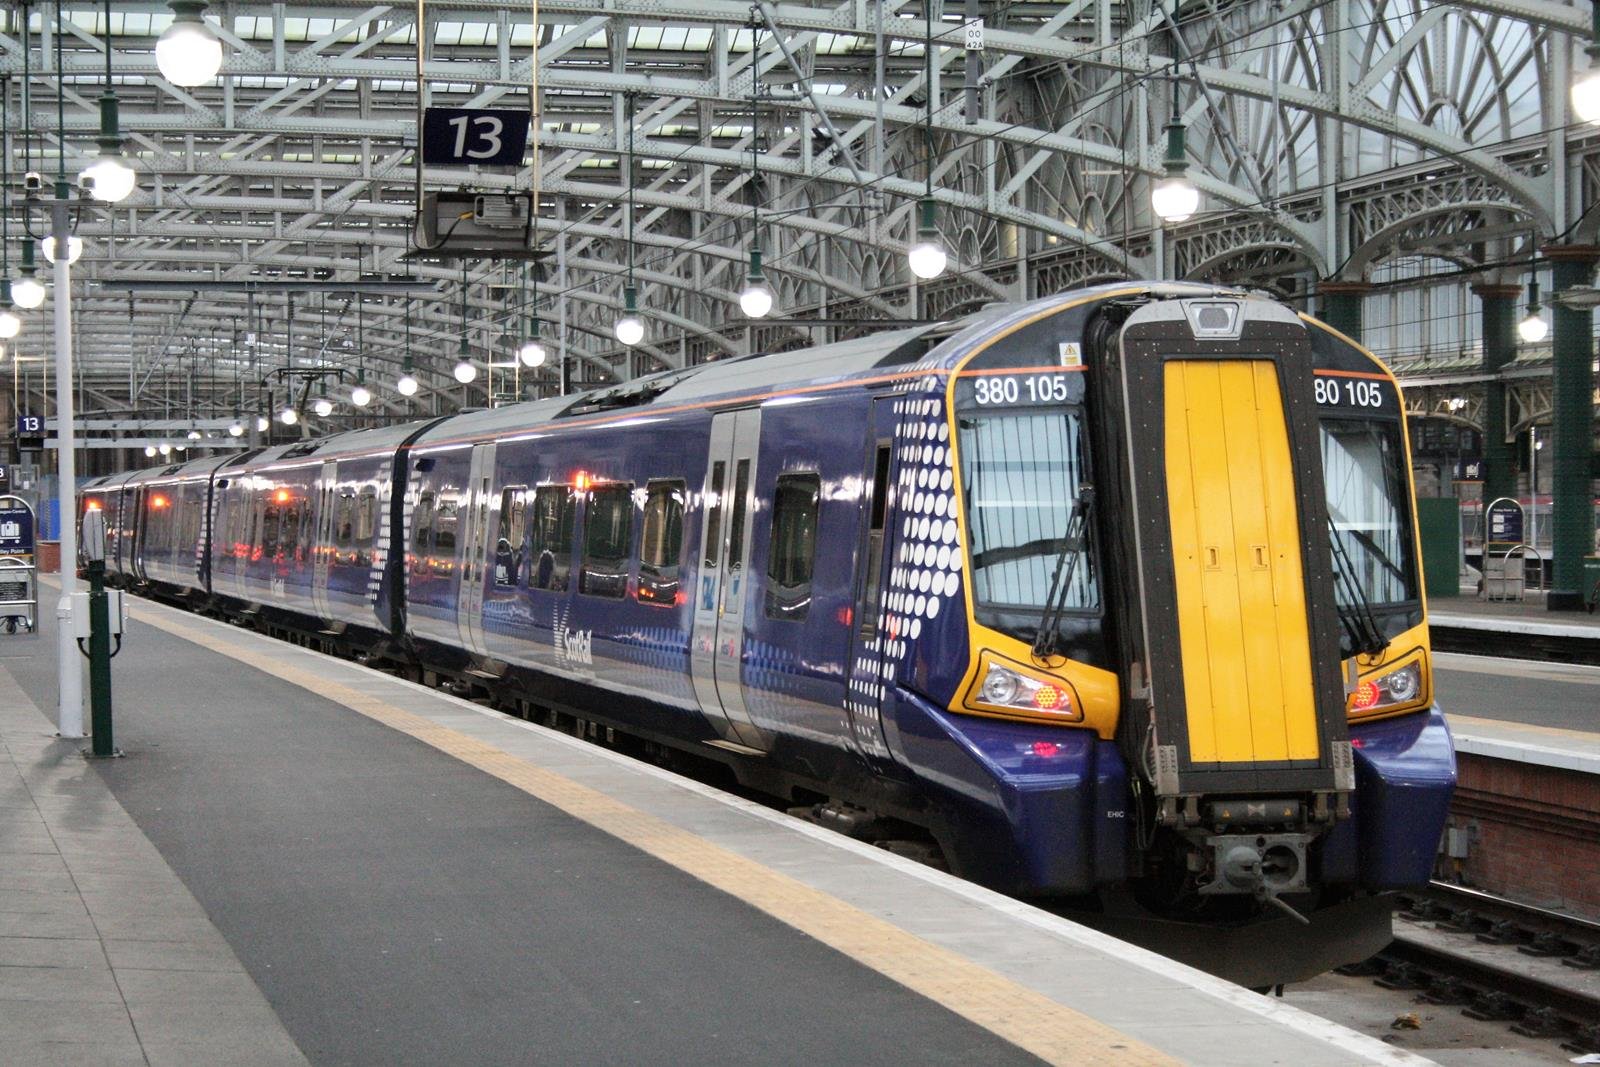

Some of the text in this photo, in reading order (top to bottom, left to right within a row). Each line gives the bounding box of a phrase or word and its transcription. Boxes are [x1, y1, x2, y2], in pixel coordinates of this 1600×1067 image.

[966, 41, 983, 49] 42A
[448, 115, 504, 159] 13
[974, 375, 1068, 404] 380 105
[1313, 378, 1382, 407] 80 105
[23, 417, 39, 431] 13
[564, 627, 593, 665] ScotRail
